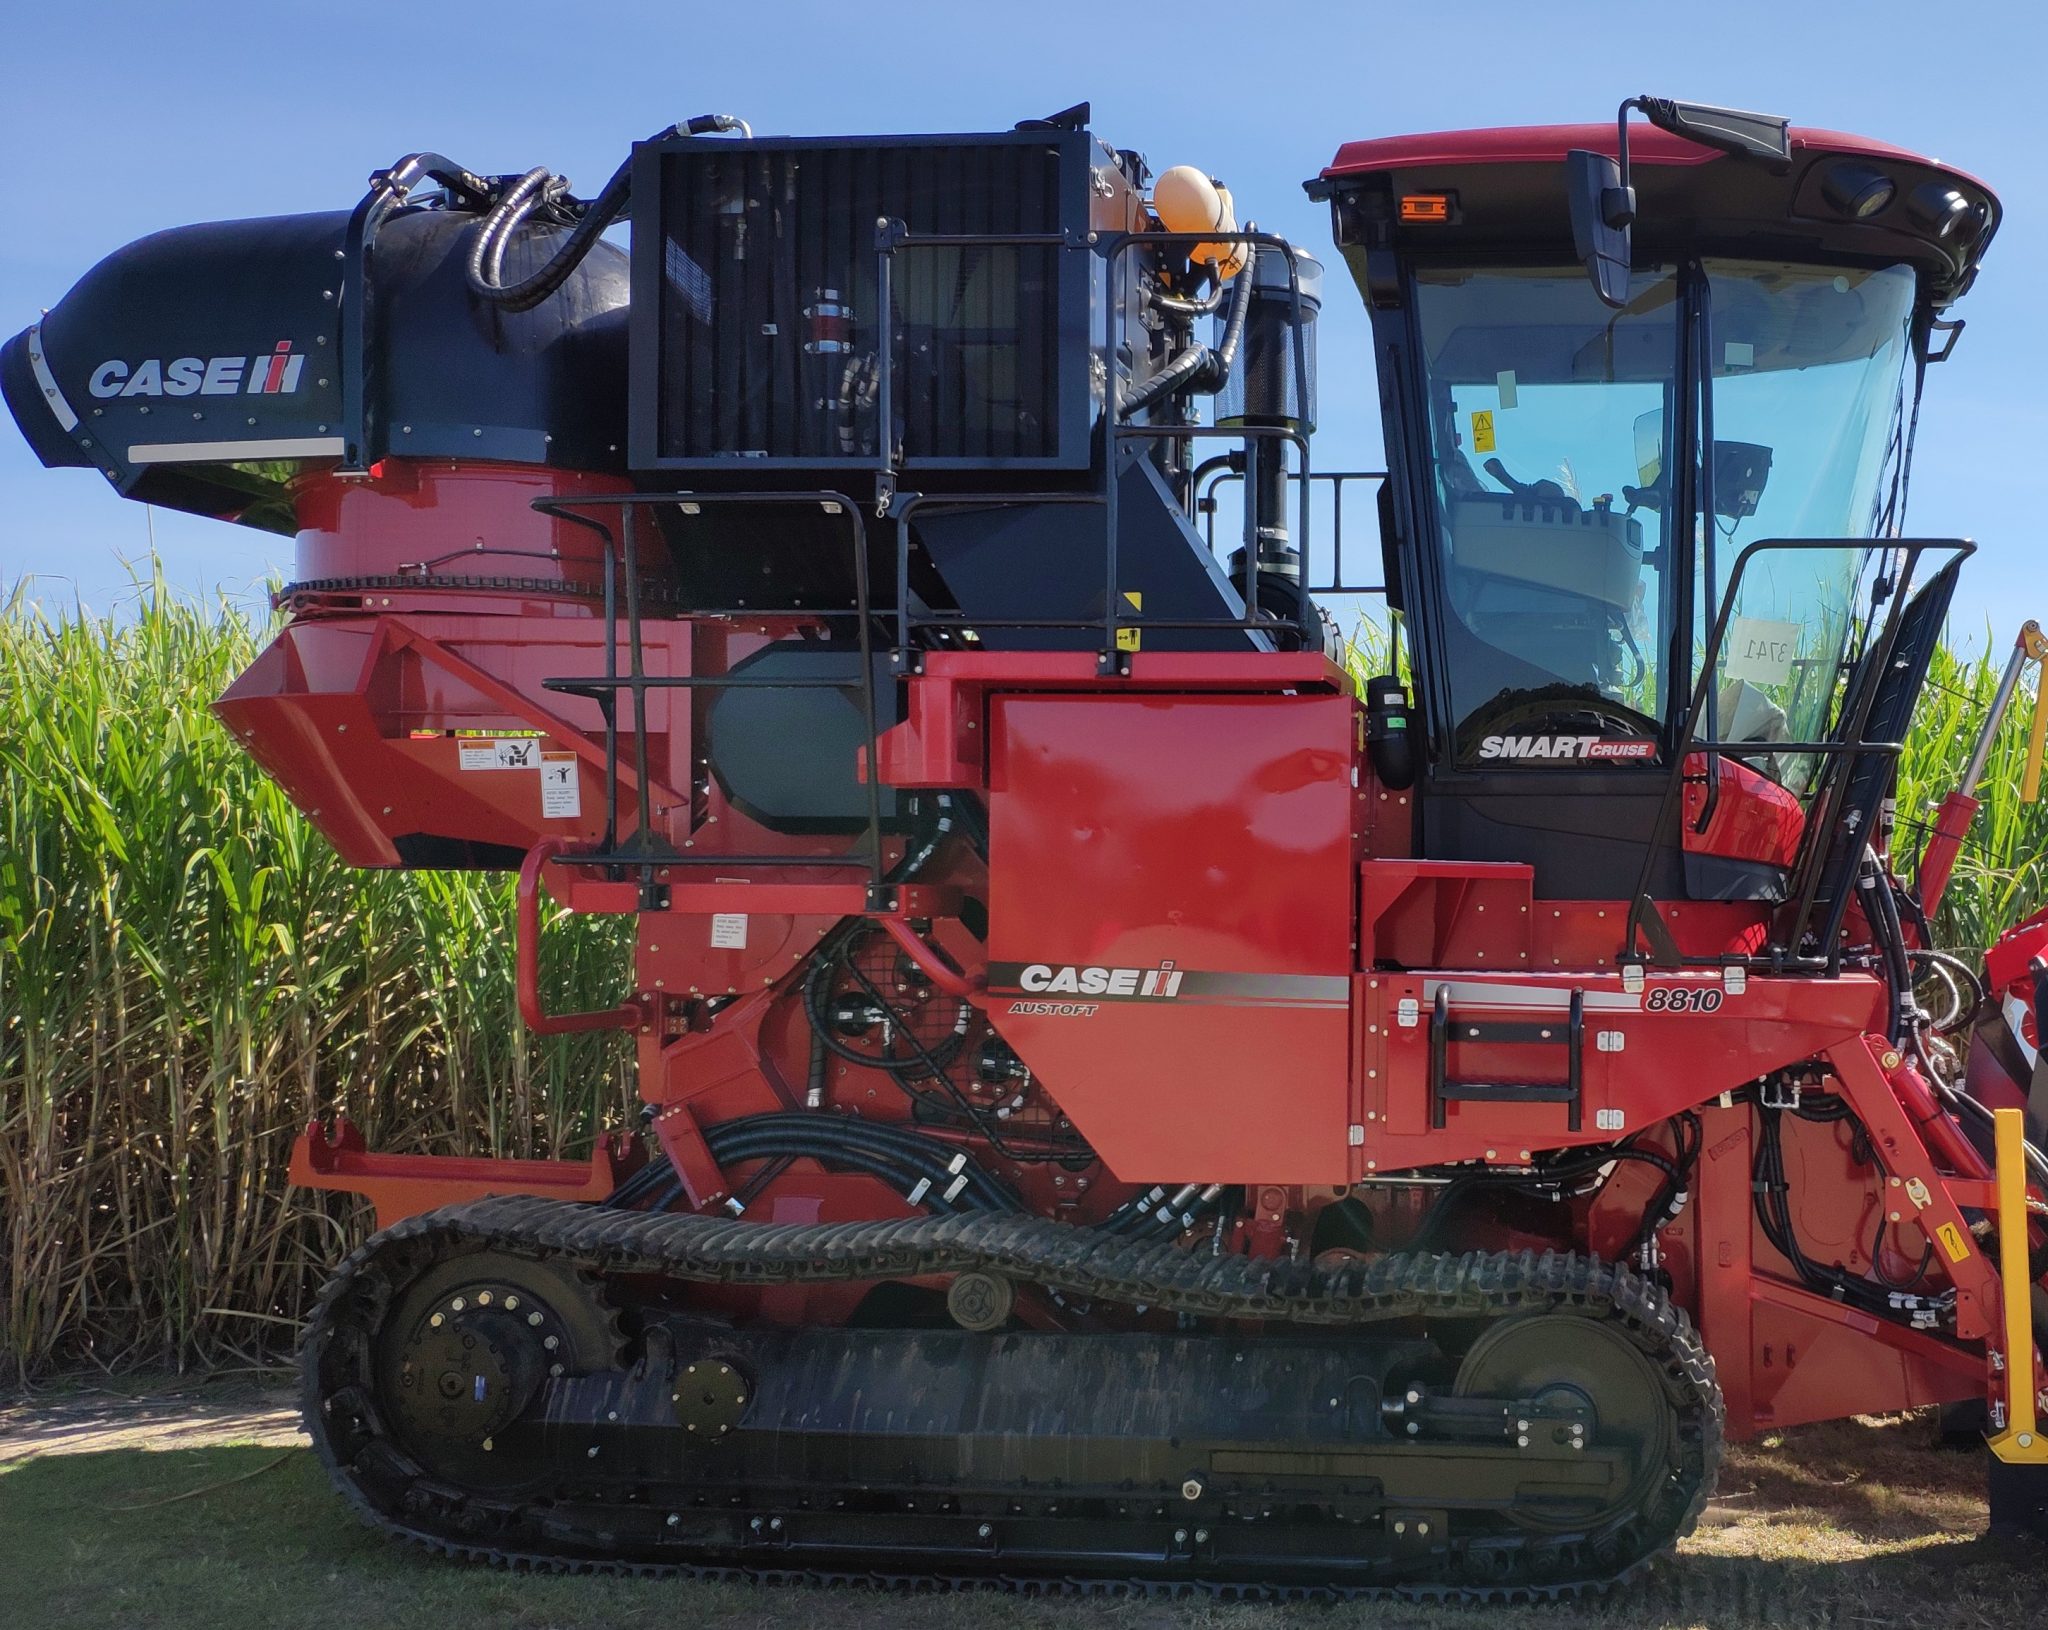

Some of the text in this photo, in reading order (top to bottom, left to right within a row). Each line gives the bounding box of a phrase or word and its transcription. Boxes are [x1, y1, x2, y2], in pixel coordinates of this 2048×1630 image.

[88, 357, 247, 398] CASE
[1479, 736, 1649, 758] SMART CRUISE
[1020, 964, 1140, 995] CASE
[1008, 1001, 1099, 1017] AUSTOFT
[1646, 987, 1723, 1013] 8810
